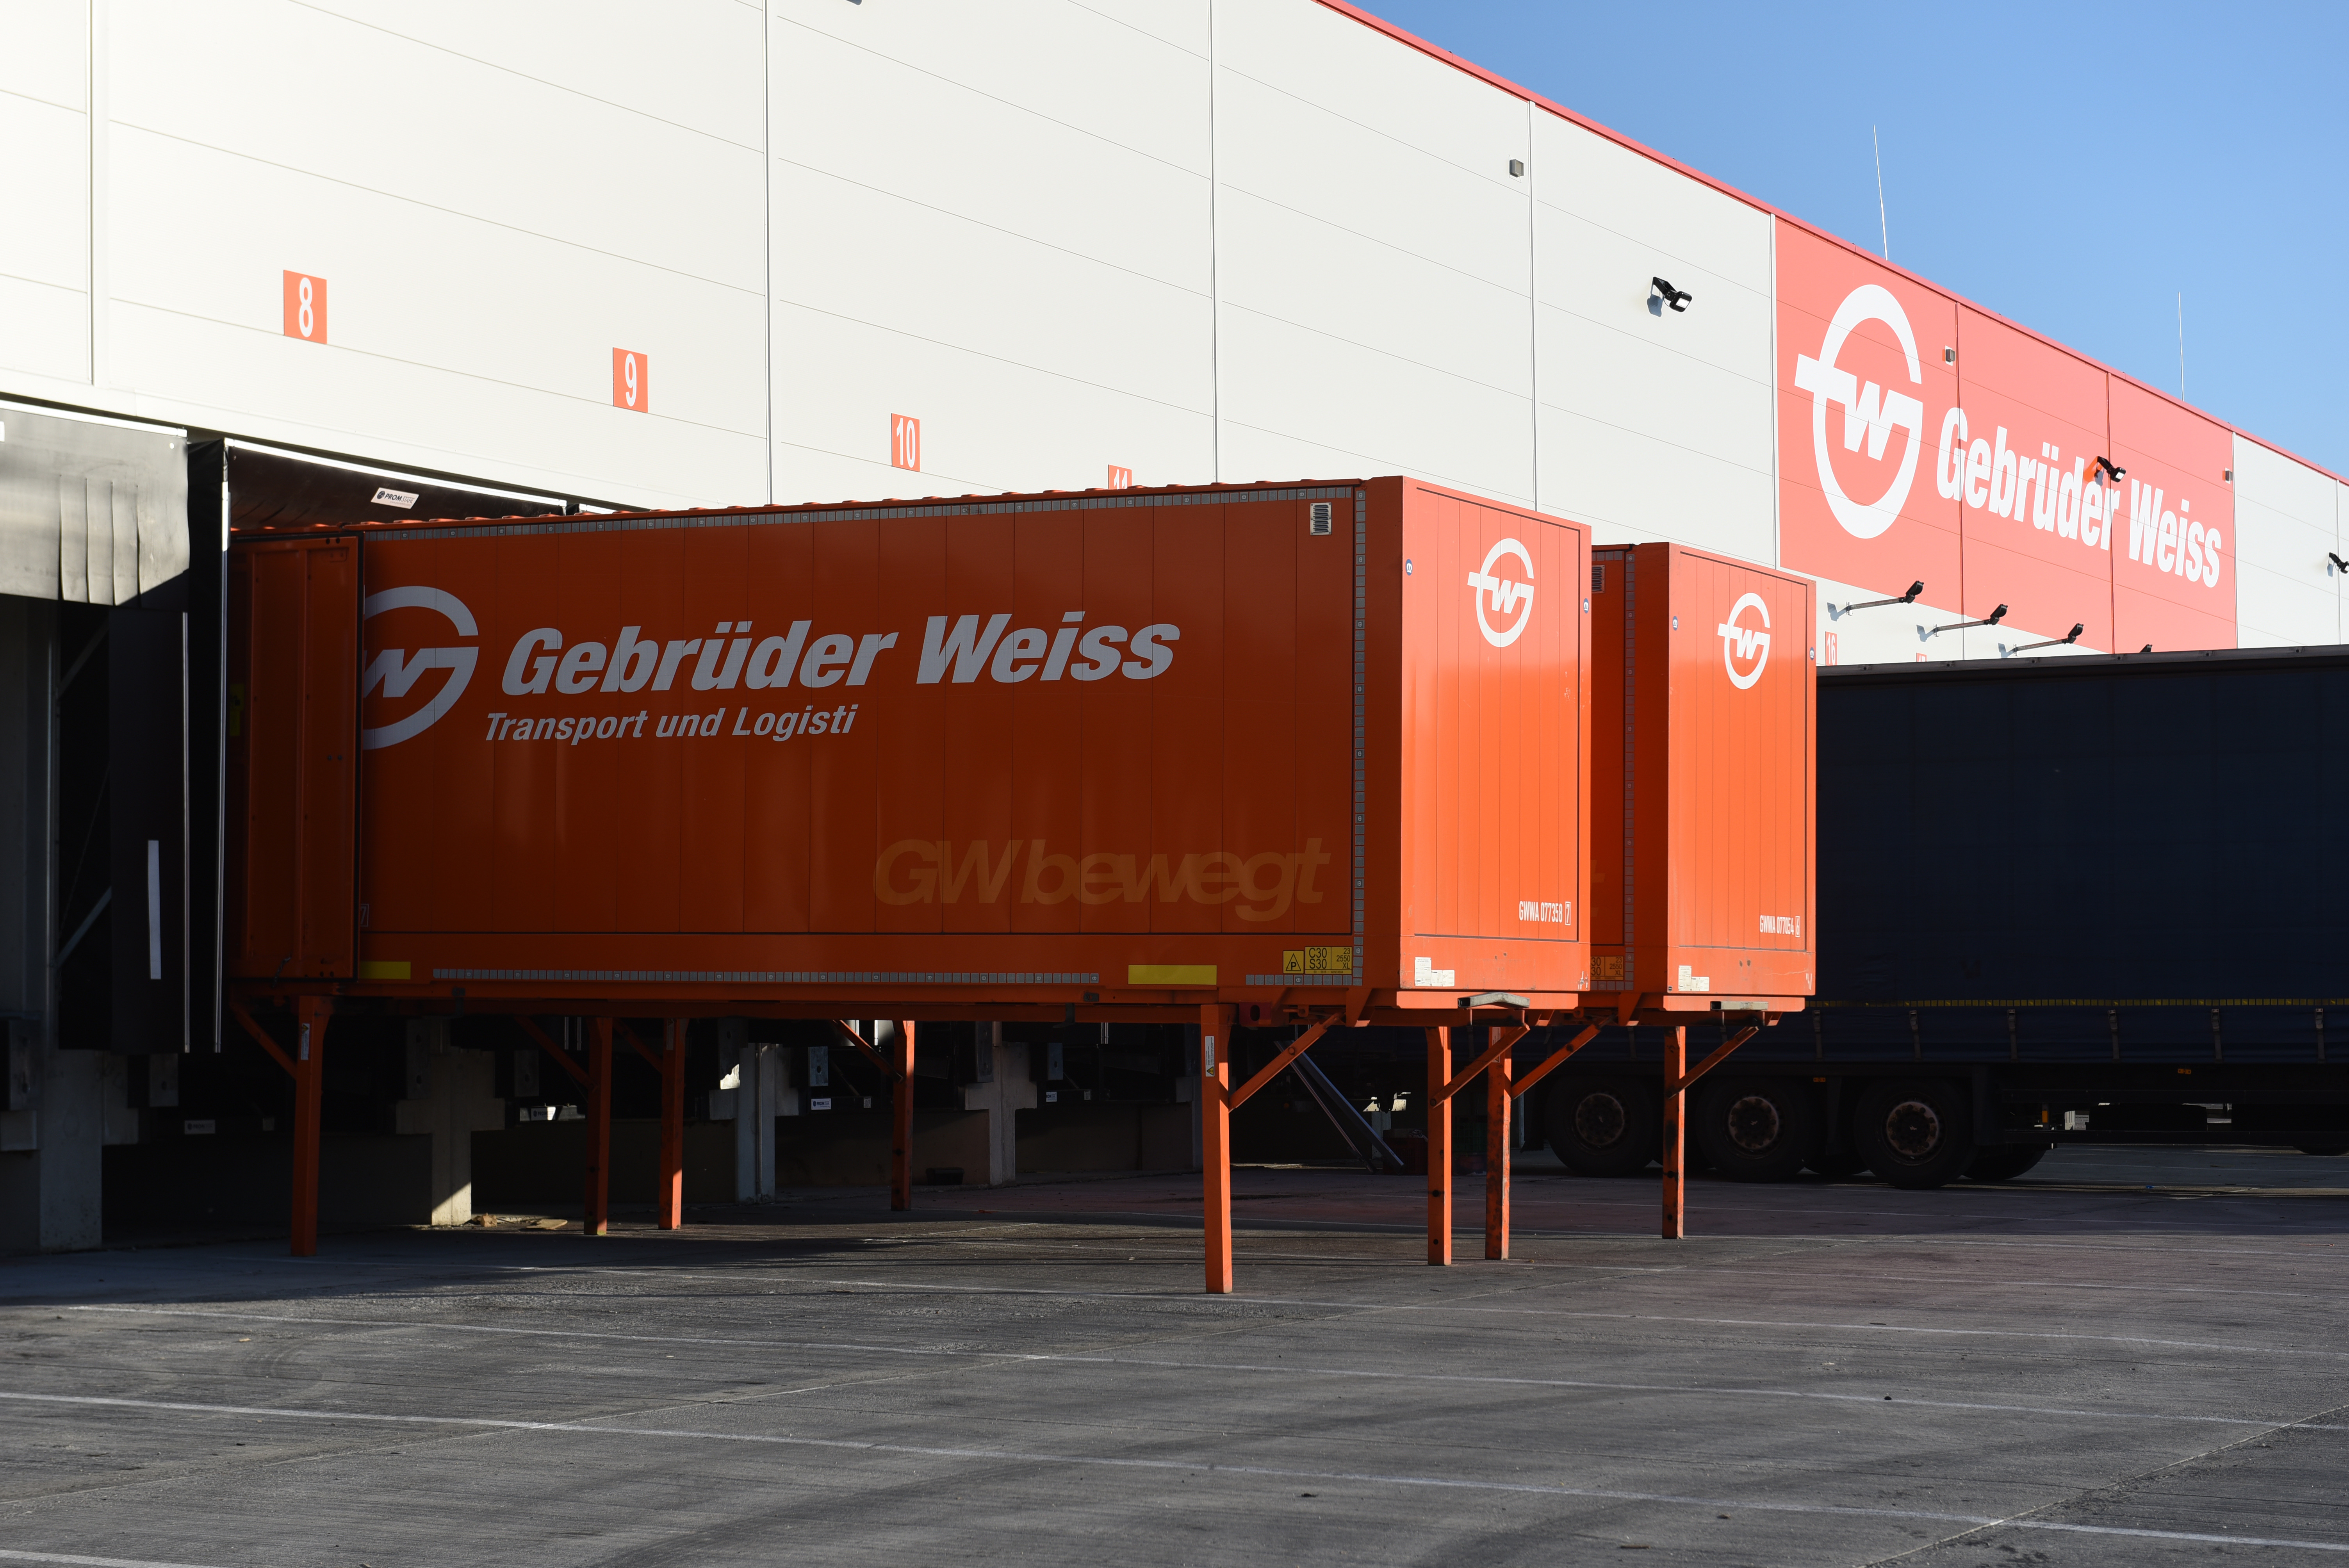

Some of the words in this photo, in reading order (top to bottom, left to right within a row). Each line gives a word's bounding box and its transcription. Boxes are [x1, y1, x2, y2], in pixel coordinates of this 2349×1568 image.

[299, 277, 314, 337] 8
[625, 353, 637, 407] 9
[896, 417, 916, 468] 10
[1937, 407, 2120, 551] Gebrüder
[2129, 479, 2221, 588] Weiss
[502, 620, 899, 696] Gebrüder
[916, 611, 1180, 684] Weiss
[1827, 633, 1836, 665] 16
[486, 710, 648, 745] Transport
[656, 707, 726, 737] und
[732, 704, 859, 742] Logisti
[1519, 900, 1539, 921] GWWA
[1541, 902, 1563, 923] 077358
[1760, 915, 1776, 934] GWWA
[1290, 962, 1297, 970] P
[1309, 948, 1327, 958] C30
[1309, 959, 1327, 969] S30
